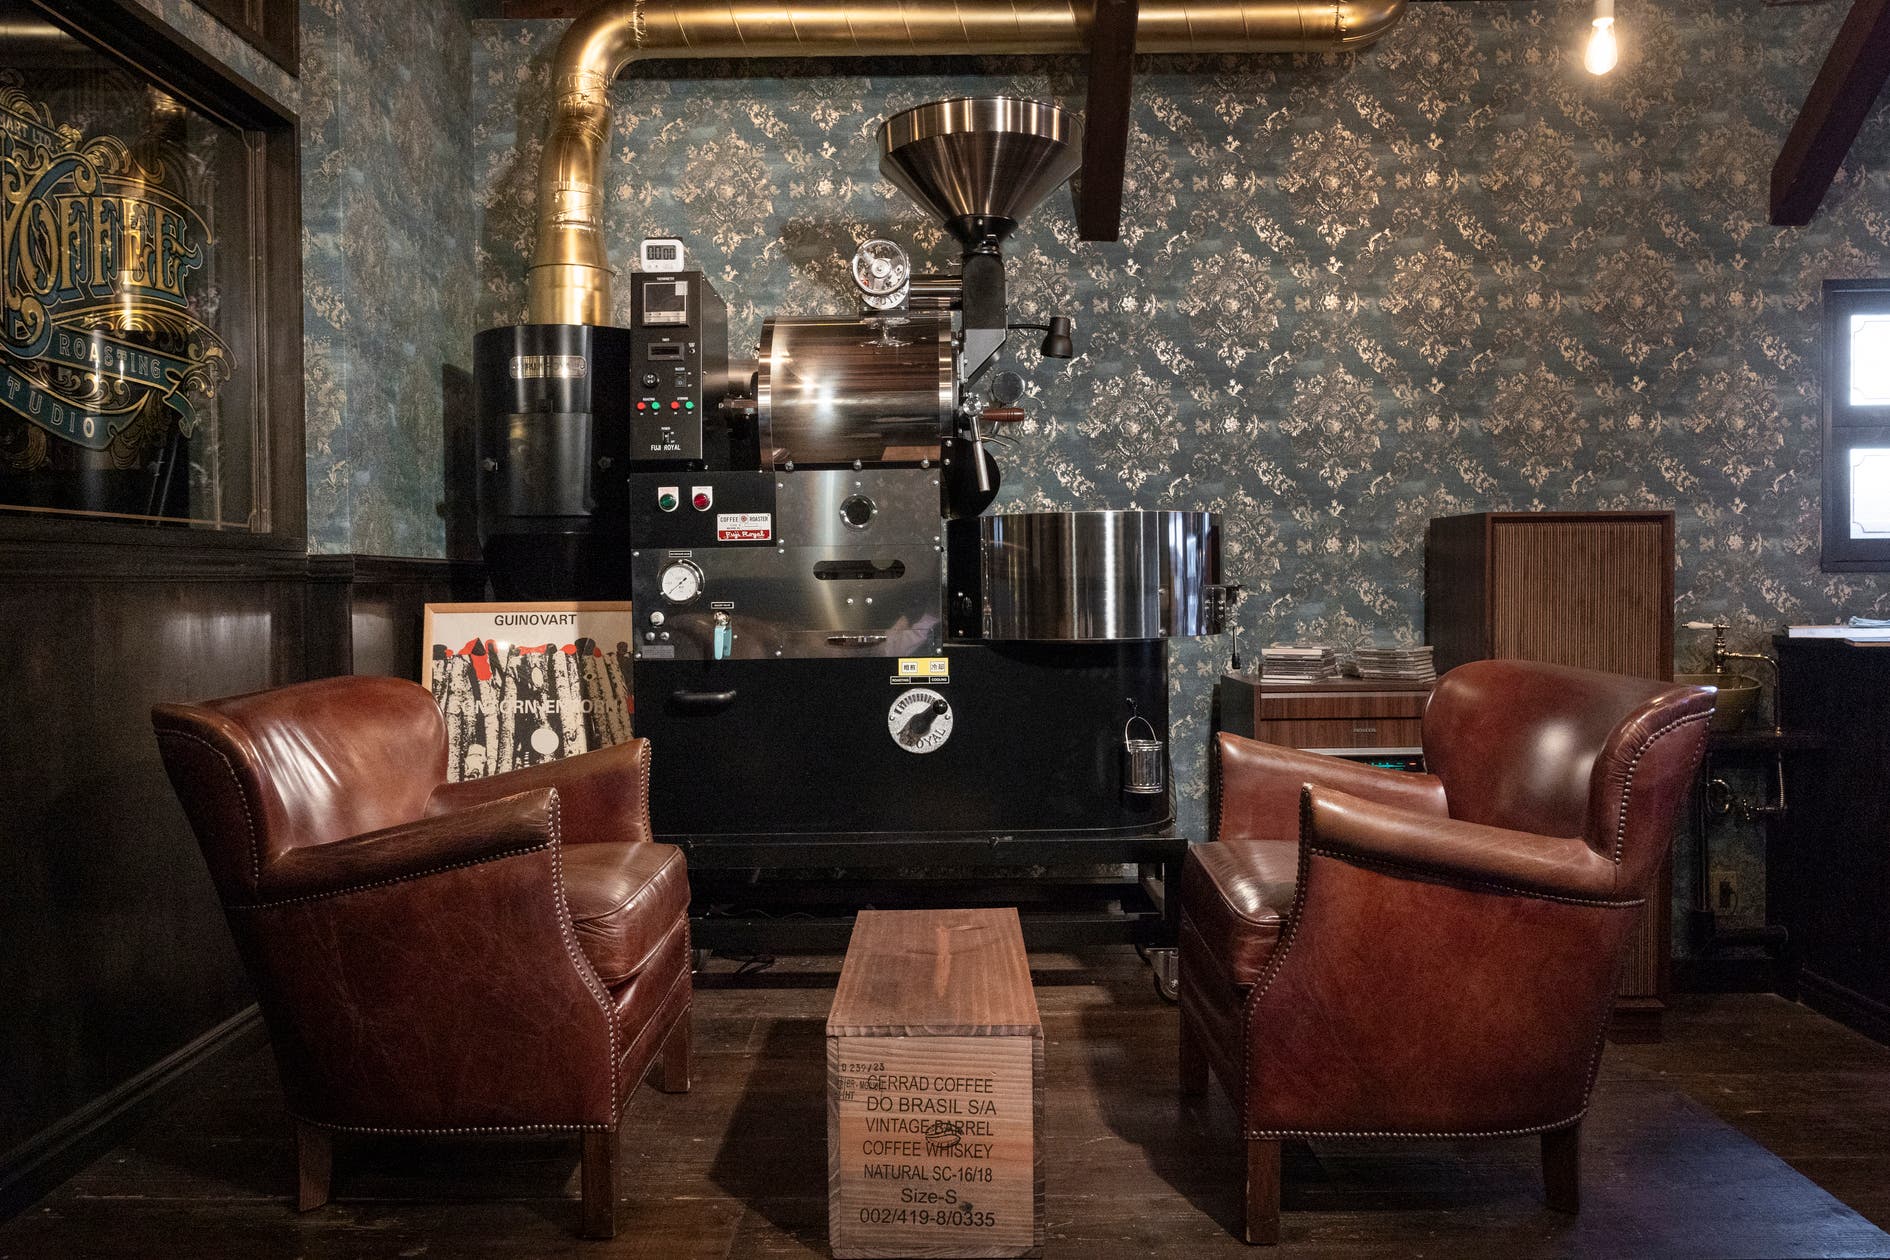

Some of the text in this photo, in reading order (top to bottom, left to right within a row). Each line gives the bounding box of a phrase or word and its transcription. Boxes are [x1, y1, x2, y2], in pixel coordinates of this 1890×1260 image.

[0, 155, 203, 358] COFFEE
[59, 332, 161, 379] ROASTING
[725, 530, 765, 539] Fuji Royal
[494, 614, 577, 626] GUINOVART
[916, 728, 946, 749] OYAL
[867, 1075, 993, 1094] CERRAD COFFEE
[867, 1096, 997, 1115] DO BRASIL S/A
[865, 1117, 994, 1136] VINTAGE BARREL
[862, 1140, 993, 1159] COFFEE WHISKEY
[864, 1164, 993, 1183] NATURAL SC-16/18
[900, 1188, 958, 1204] Size-S
[859, 1208, 995, 1227] 002/419-8/0335
